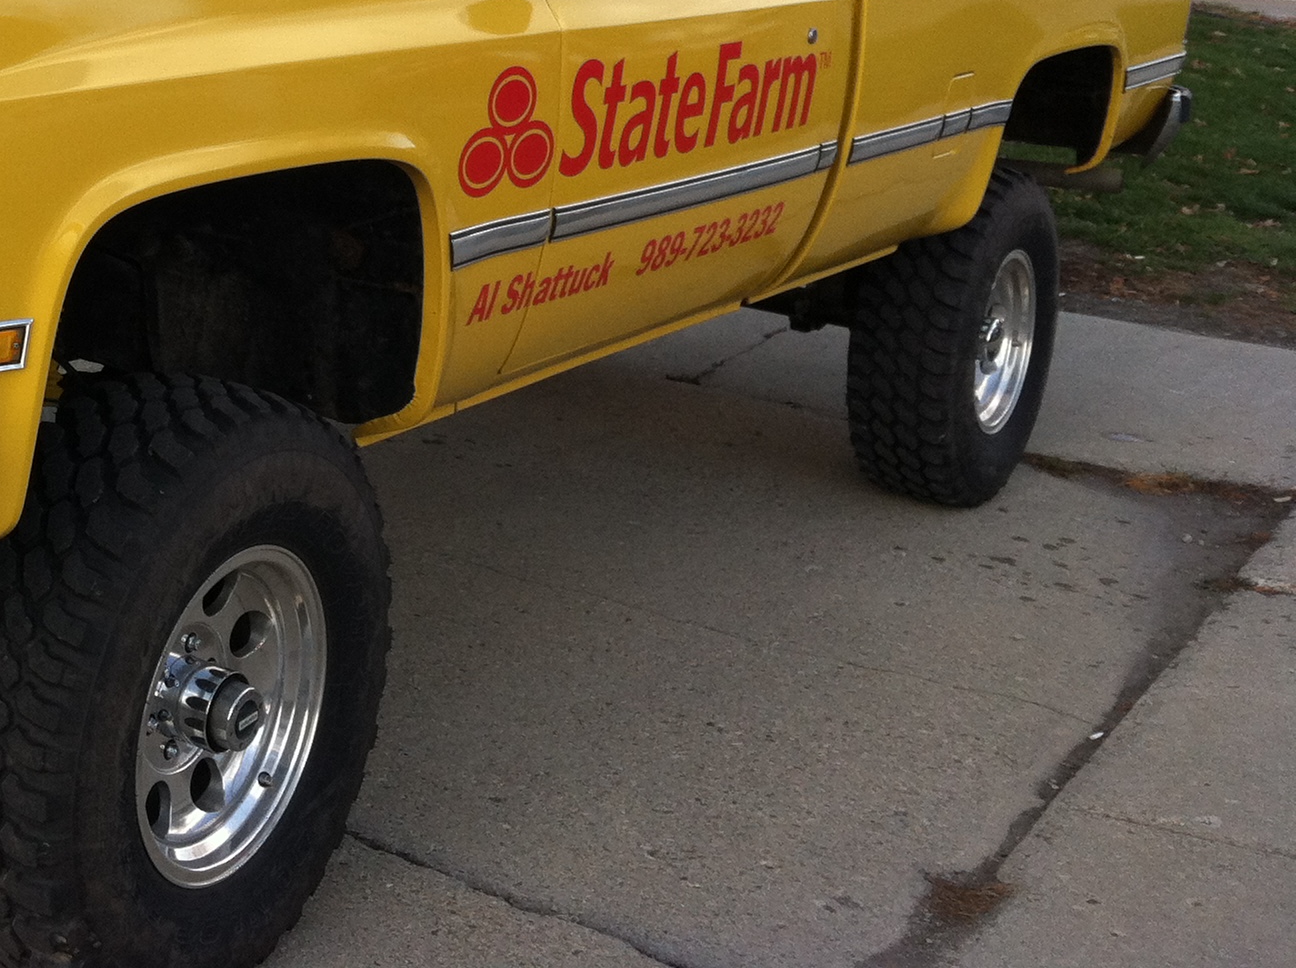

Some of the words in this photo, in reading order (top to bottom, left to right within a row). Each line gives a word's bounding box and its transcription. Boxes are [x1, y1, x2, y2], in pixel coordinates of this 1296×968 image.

[558, 40, 818, 178] StateFarm
[465, 281, 501, 327] Al
[501, 251, 616, 316] Shattuck
[635, 201, 786, 276] 989-723-3232
